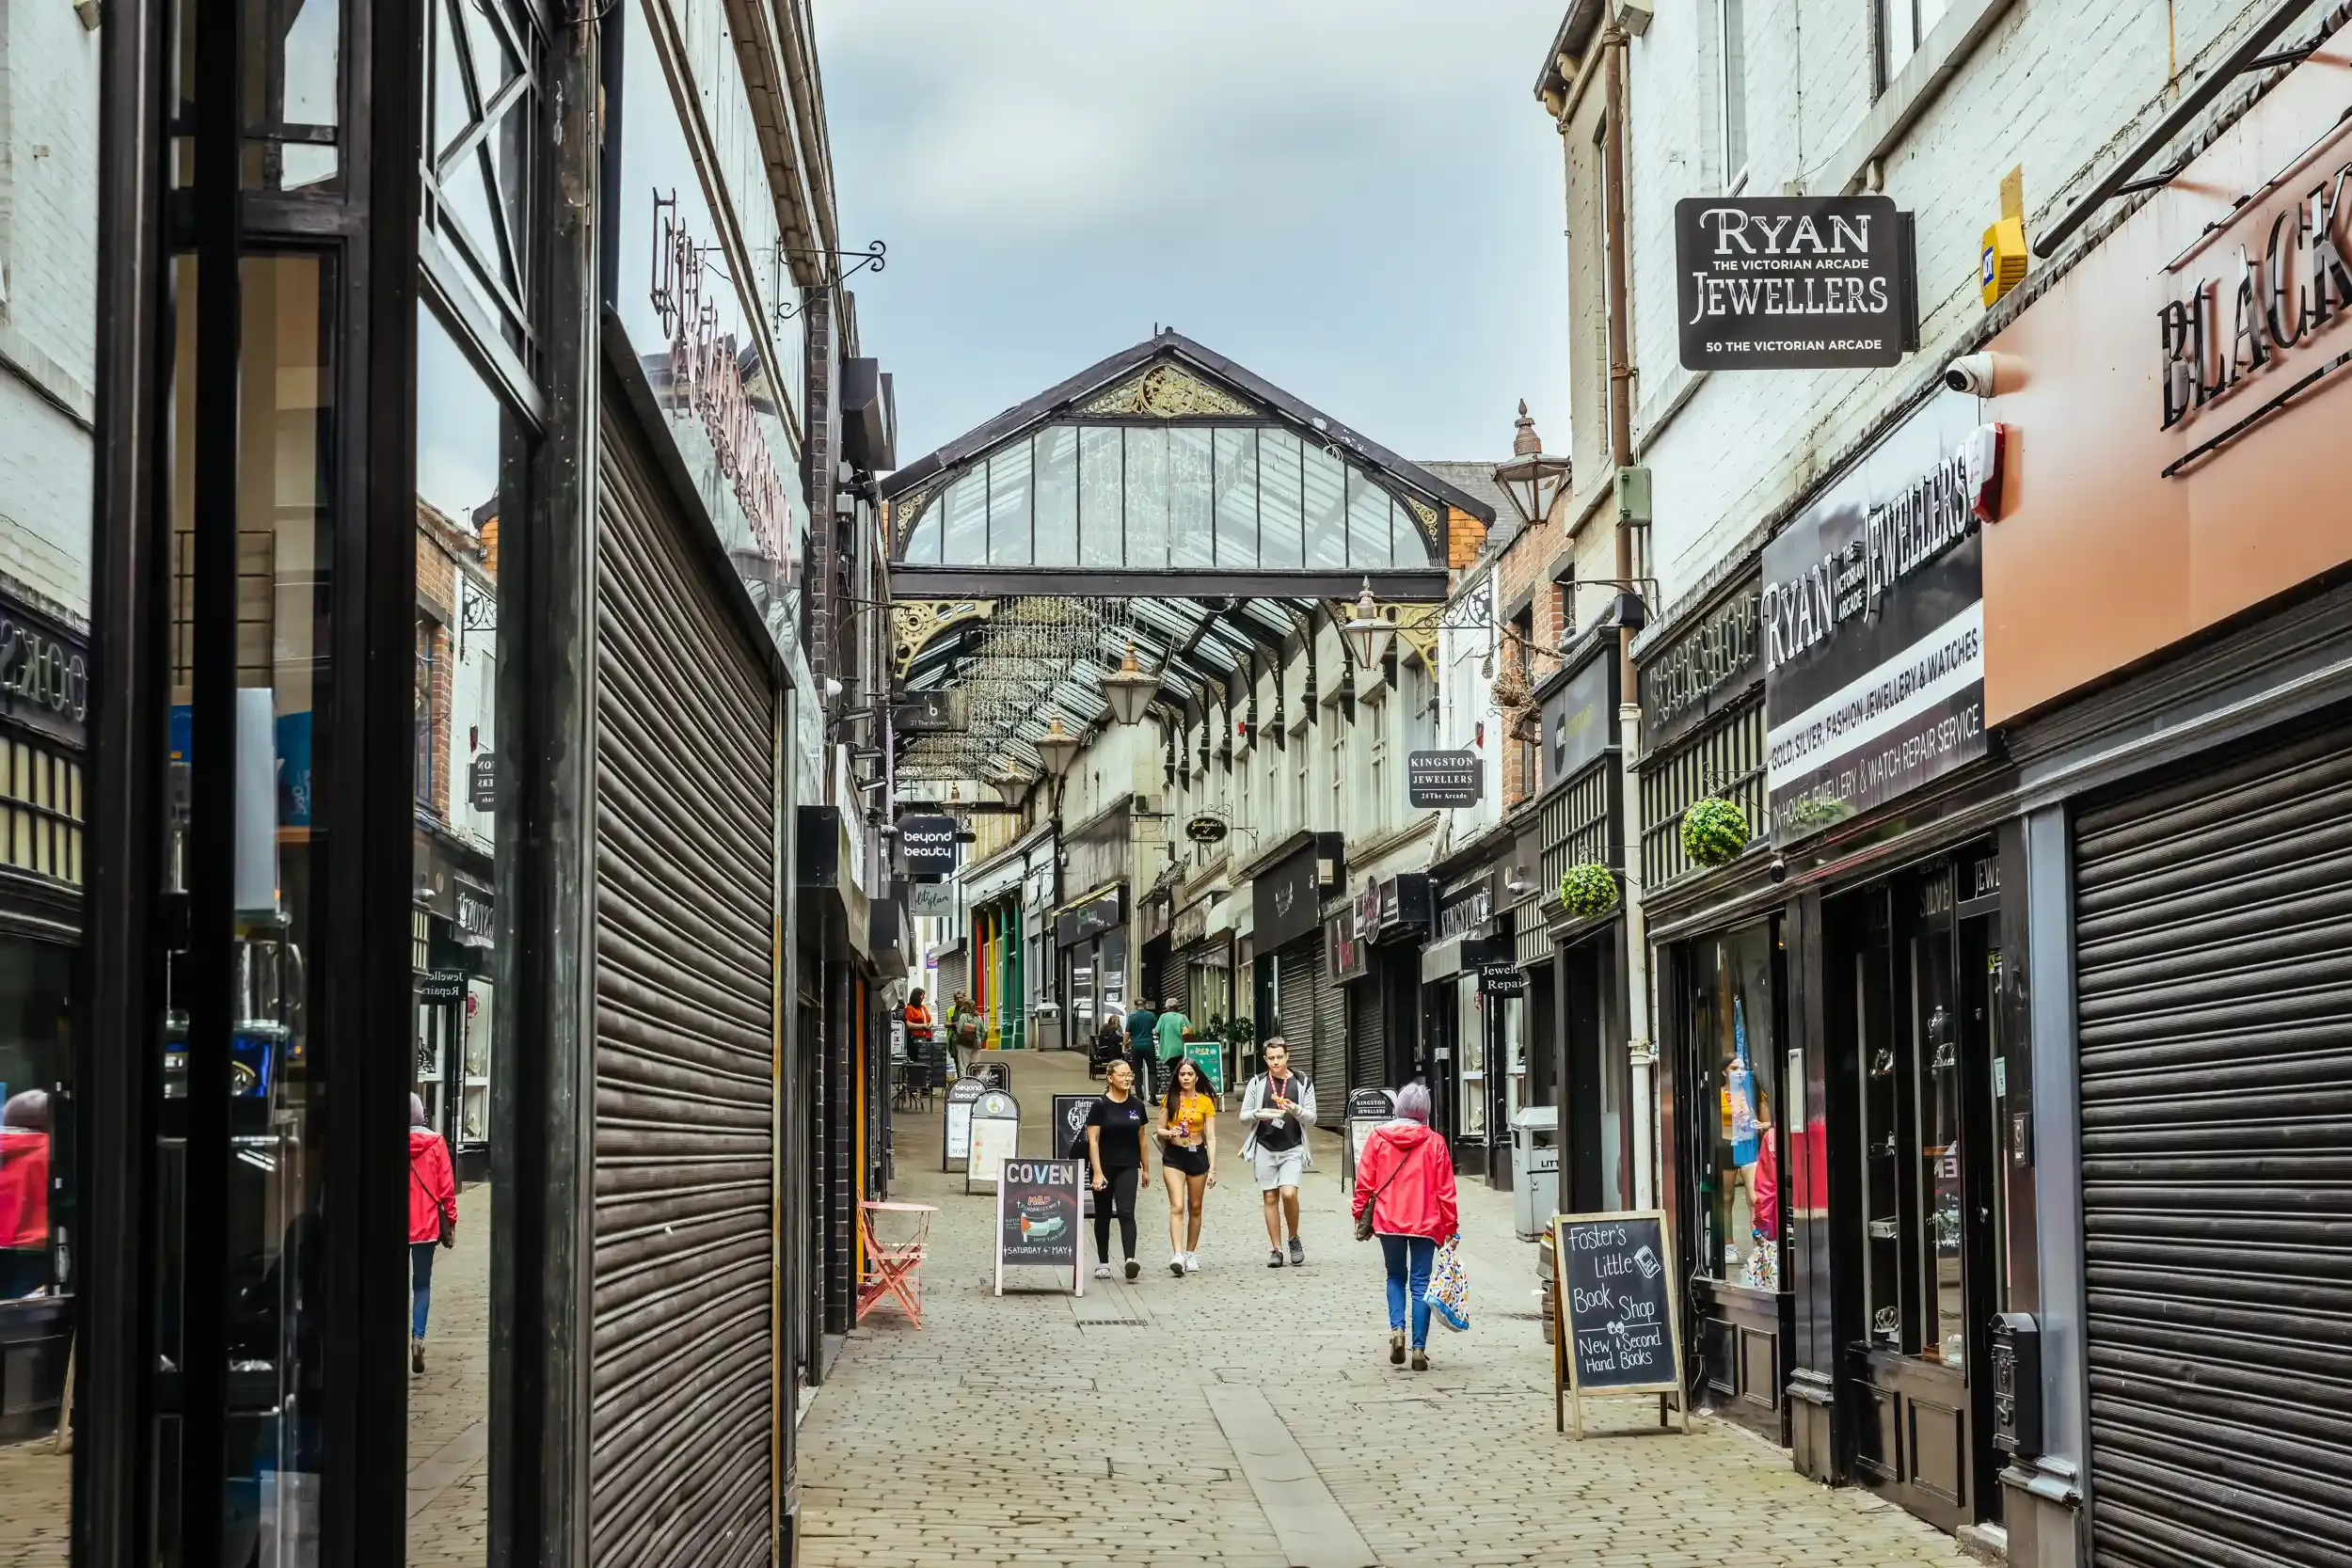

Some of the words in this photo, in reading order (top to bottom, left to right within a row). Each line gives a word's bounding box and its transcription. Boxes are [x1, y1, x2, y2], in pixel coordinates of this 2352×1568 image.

[1699, 208, 1871, 255] RYAN
[1712, 261, 1739, 271] THE
[1740, 260, 1813, 271] VICTORIAN
[1815, 259, 1869, 270] ARCADE
[1689, 272, 1889, 325] JEWELLERS
[1706, 341, 1723, 353] 50
[1725, 341, 1751, 352] THE
[1754, 341, 1825, 352] VICTORIAN
[1828, 340, 1883, 350] ARCADE
[1862, 443, 1967, 624] JEWELLERS
[1842, 540, 1855, 566] THE
[1834, 562, 1867, 599] VICTORIAN
[1761, 551, 1834, 674] RYAN
[1837, 587, 1863, 623] ARCADE
[1771, 741, 1795, 772] GOLD,
[1795, 723, 1826, 759] SILVER,
[1826, 698, 1864, 743] FASHION
[1865, 668, 1918, 721] JEWELLERY
[1919, 665, 1927, 689] &
[1927, 626, 1979, 685] WATCHES
[1411, 756, 1474, 768] KINGSTON
[1772, 790, 1809, 831] IN-HOUSE
[1810, 767, 1858, 814] JEWELLERY
[1859, 758, 1867, 794] &
[1867, 749, 1901, 787] WATCH
[1902, 727, 1936, 769] REPAIR
[1937, 703, 1979, 753] SERVICE
[1413, 774, 1473, 784] JEWELLERS
[903, 831, 952, 844] beyond
[903, 847, 951, 859] beauty
[1919, 877, 1949, 918] SILVE
[1487, 977, 1522, 991] Repai
[1007, 1163, 1073, 1185] COVEN
[1540, 1160, 1559, 1168] LITT
[1008, 1246, 1041, 1255] SATURDAY
[1052, 1246, 1068, 1255] MAY
[1568, 1224, 1627, 1252] Foster's
[1594, 1252, 1633, 1279] Little
[1573, 1282, 1615, 1314] Book
[1618, 1295, 1656, 1323] Shop
[1579, 1337, 1611, 1357] New
[1621, 1326, 1662, 1353] Second
[1585, 1351, 1616, 1373] Hand
[1619, 1348, 1653, 1370] Books
